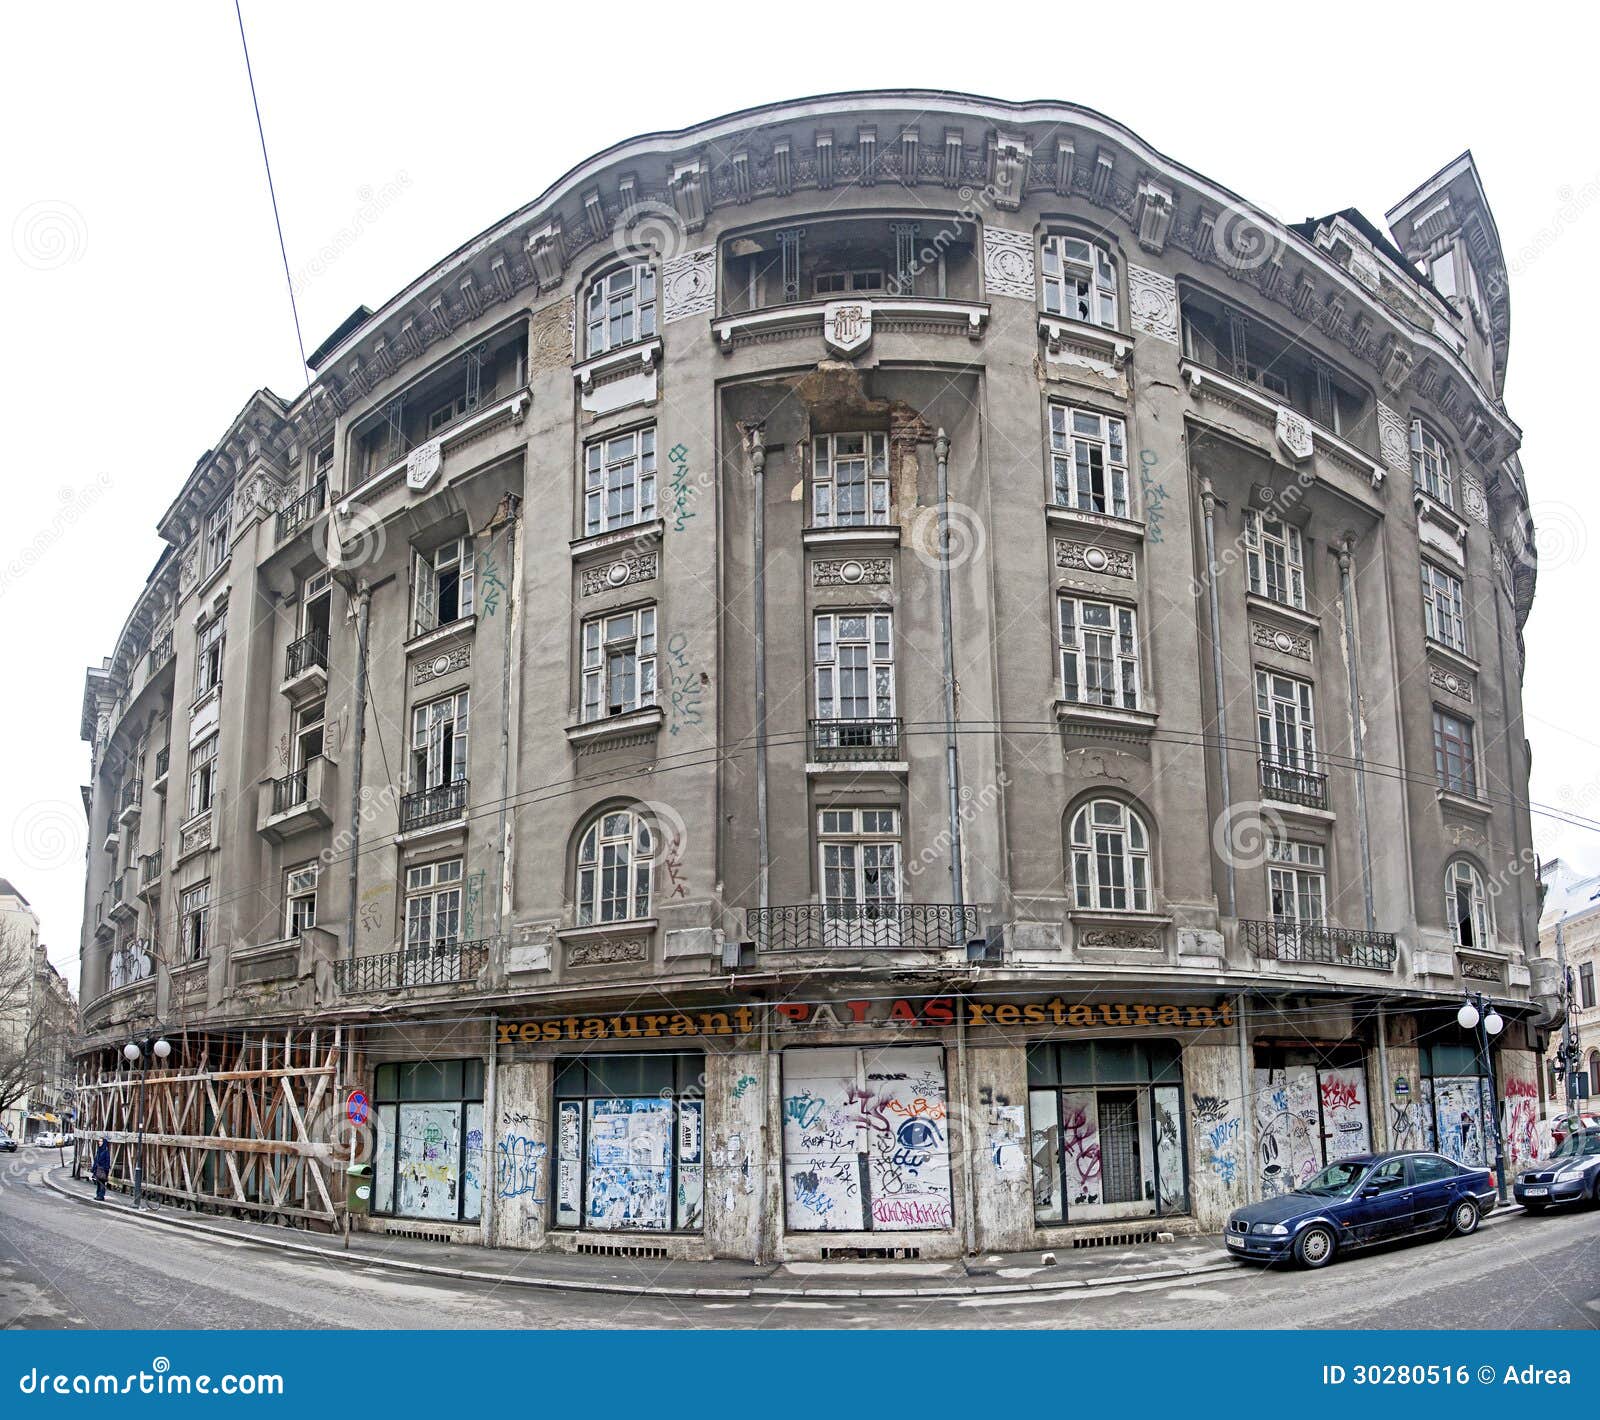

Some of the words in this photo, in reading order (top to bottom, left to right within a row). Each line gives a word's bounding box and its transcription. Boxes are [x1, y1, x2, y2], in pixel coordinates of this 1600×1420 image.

[497, 1005, 752, 1044] restaurant
[776, 998, 953, 1032] PALAS
[968, 998, 1233, 1027] restaurant
